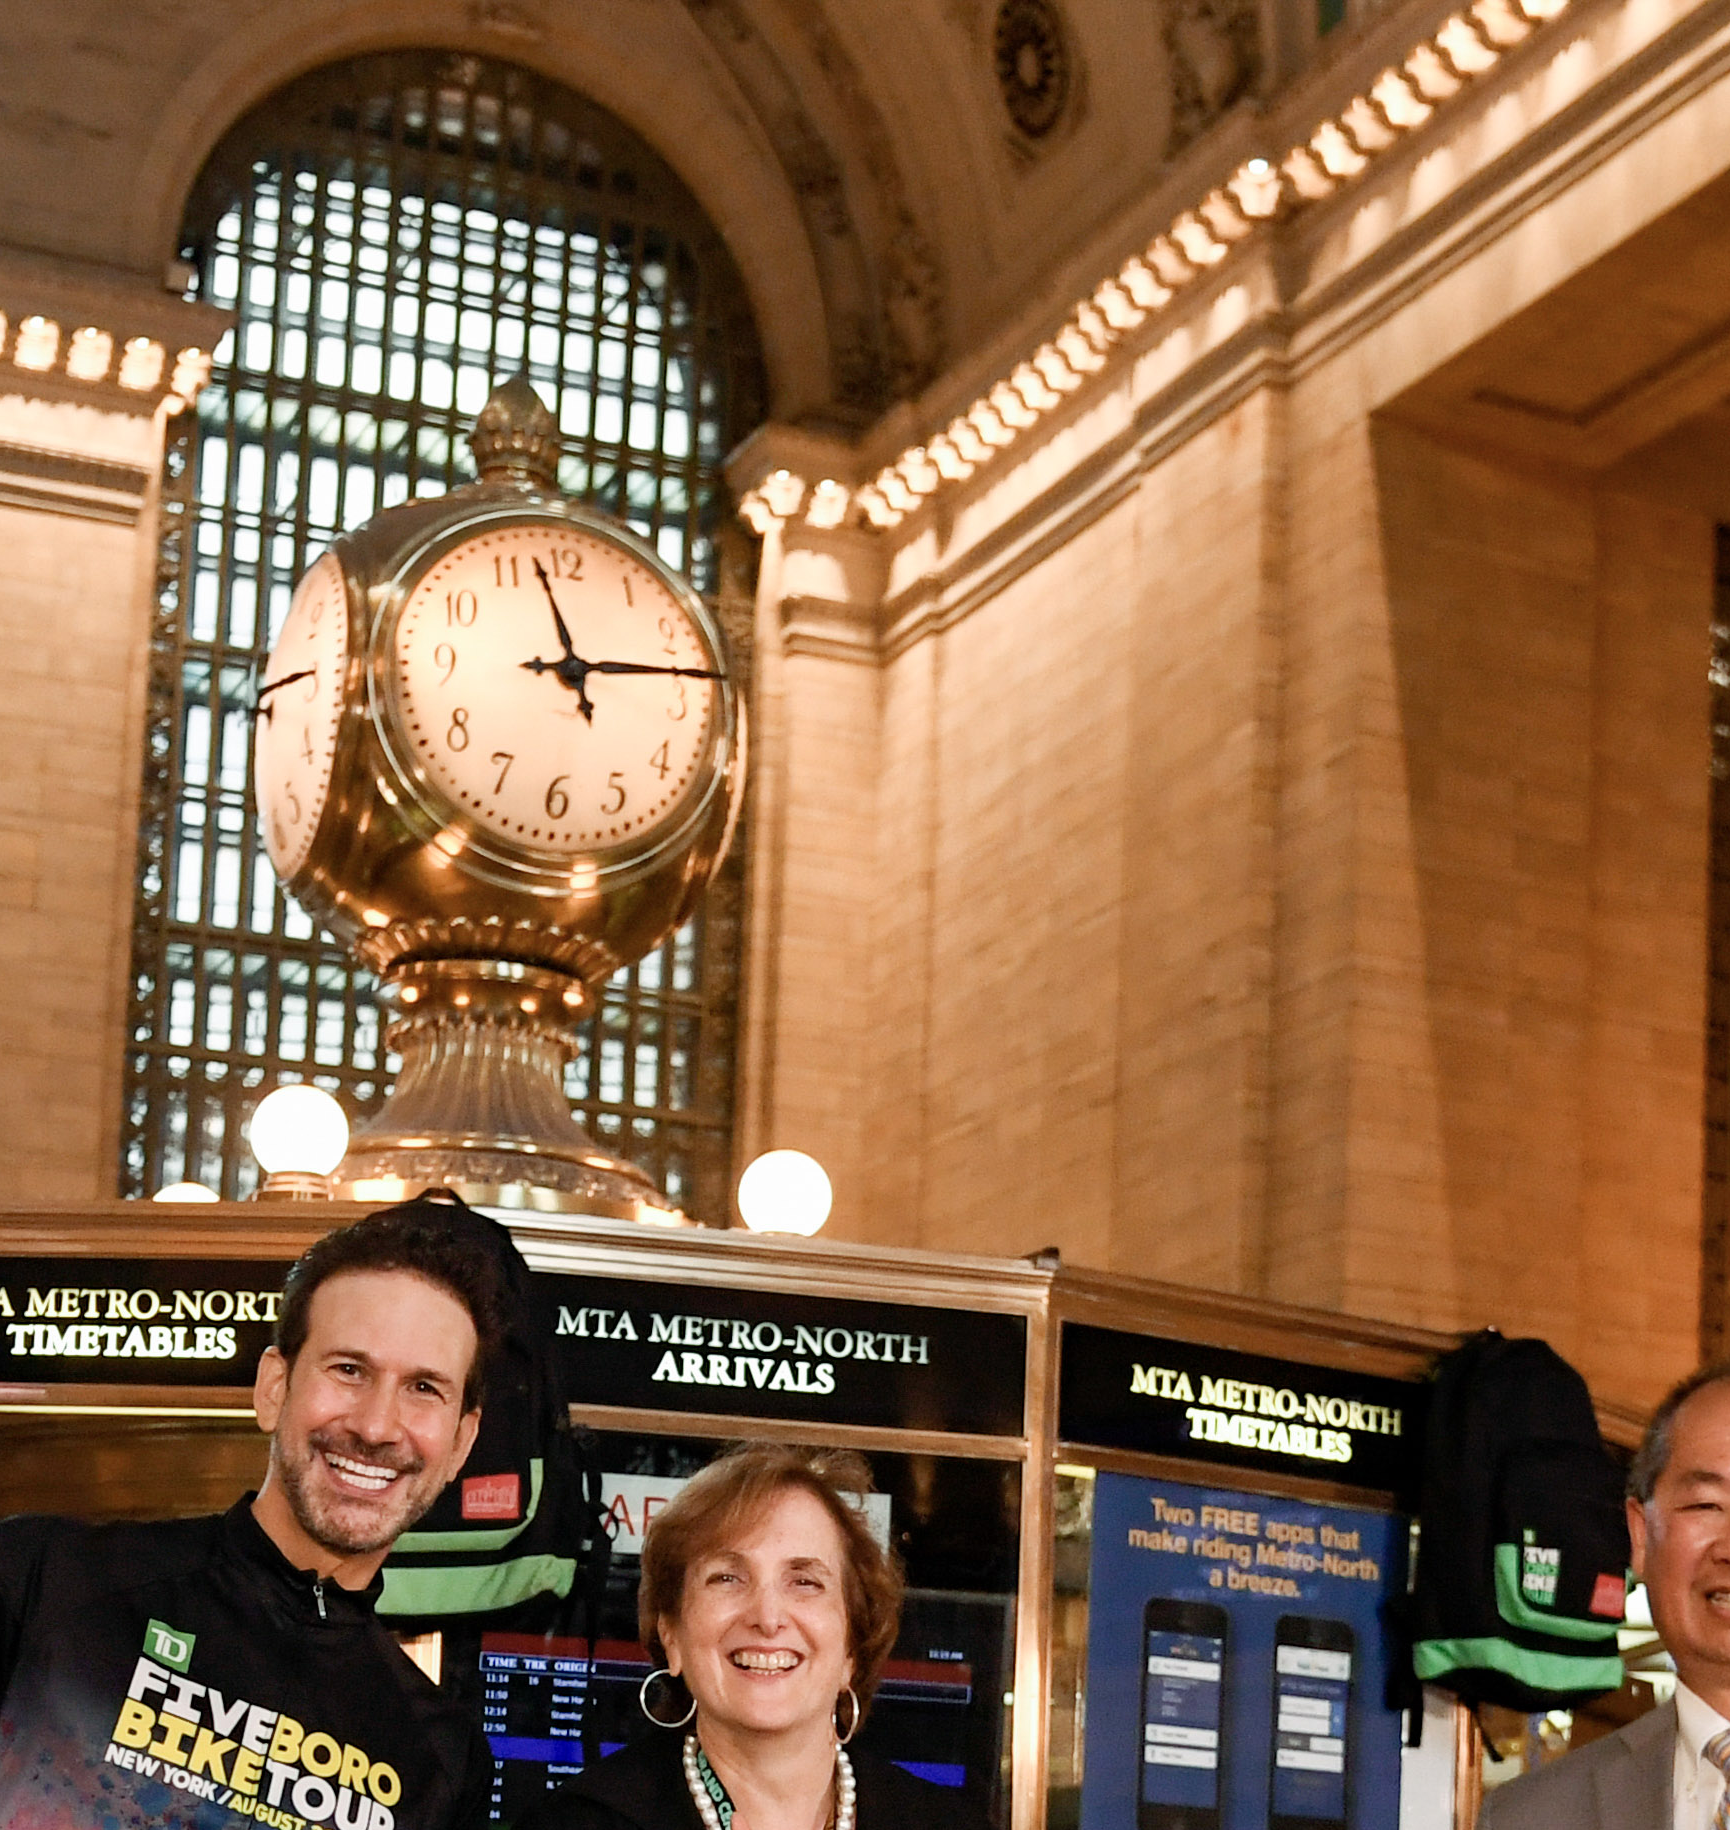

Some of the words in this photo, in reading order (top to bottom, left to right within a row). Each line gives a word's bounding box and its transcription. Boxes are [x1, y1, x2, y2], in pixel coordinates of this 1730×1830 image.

[493, 554, 519, 588] 11
[549, 547, 583, 582] 12
[444, 590, 478, 627] 10
[622, 575, 635, 607] 1
[656, 616, 677, 655] 2
[433, 642, 457, 686] 9
[666, 682, 688, 722] 3
[446, 707, 470, 752] 8
[490, 751, 515, 797] 7
[648, 738, 671, 781] 4
[544, 774, 571, 820] 6
[600, 772, 626, 816] 5
[24, 1287, 284, 1322] METRO-NORT
[6, 1322, 238, 1360] TIMETABLES
[555, 1305, 639, 1342] MTA
[647, 1312, 930, 1365] METRO-NORTH
[651, 1350, 836, 1395] ARRIVALS
[1129, 1363, 1195, 1403] MTA
[1198, 1375, 1402, 1437] METRO-NORTH
[1185, 1406, 1353, 1462] TIMETABLES
[1151, 1497, 1195, 1527] Two
[1200, 1504, 1260, 1537] FREE
[1265, 1519, 1316, 1547] apps
[1320, 1523, 1360, 1552] that
[1128, 1527, 1188, 1555] make
[1192, 1534, 1252, 1569] riding
[1255, 1541, 1380, 1582] Metro-North
[1208, 1567, 1223, 1588] a
[1227, 1567, 1302, 1598] breeze.
[149, 1627, 188, 1664] TD
[486, 1656, 517, 1670] TIME
[523, 1659, 547, 1671] TRK
[104, 1742, 161, 1778] NEW
[160, 1758, 219, 1802] YORK
